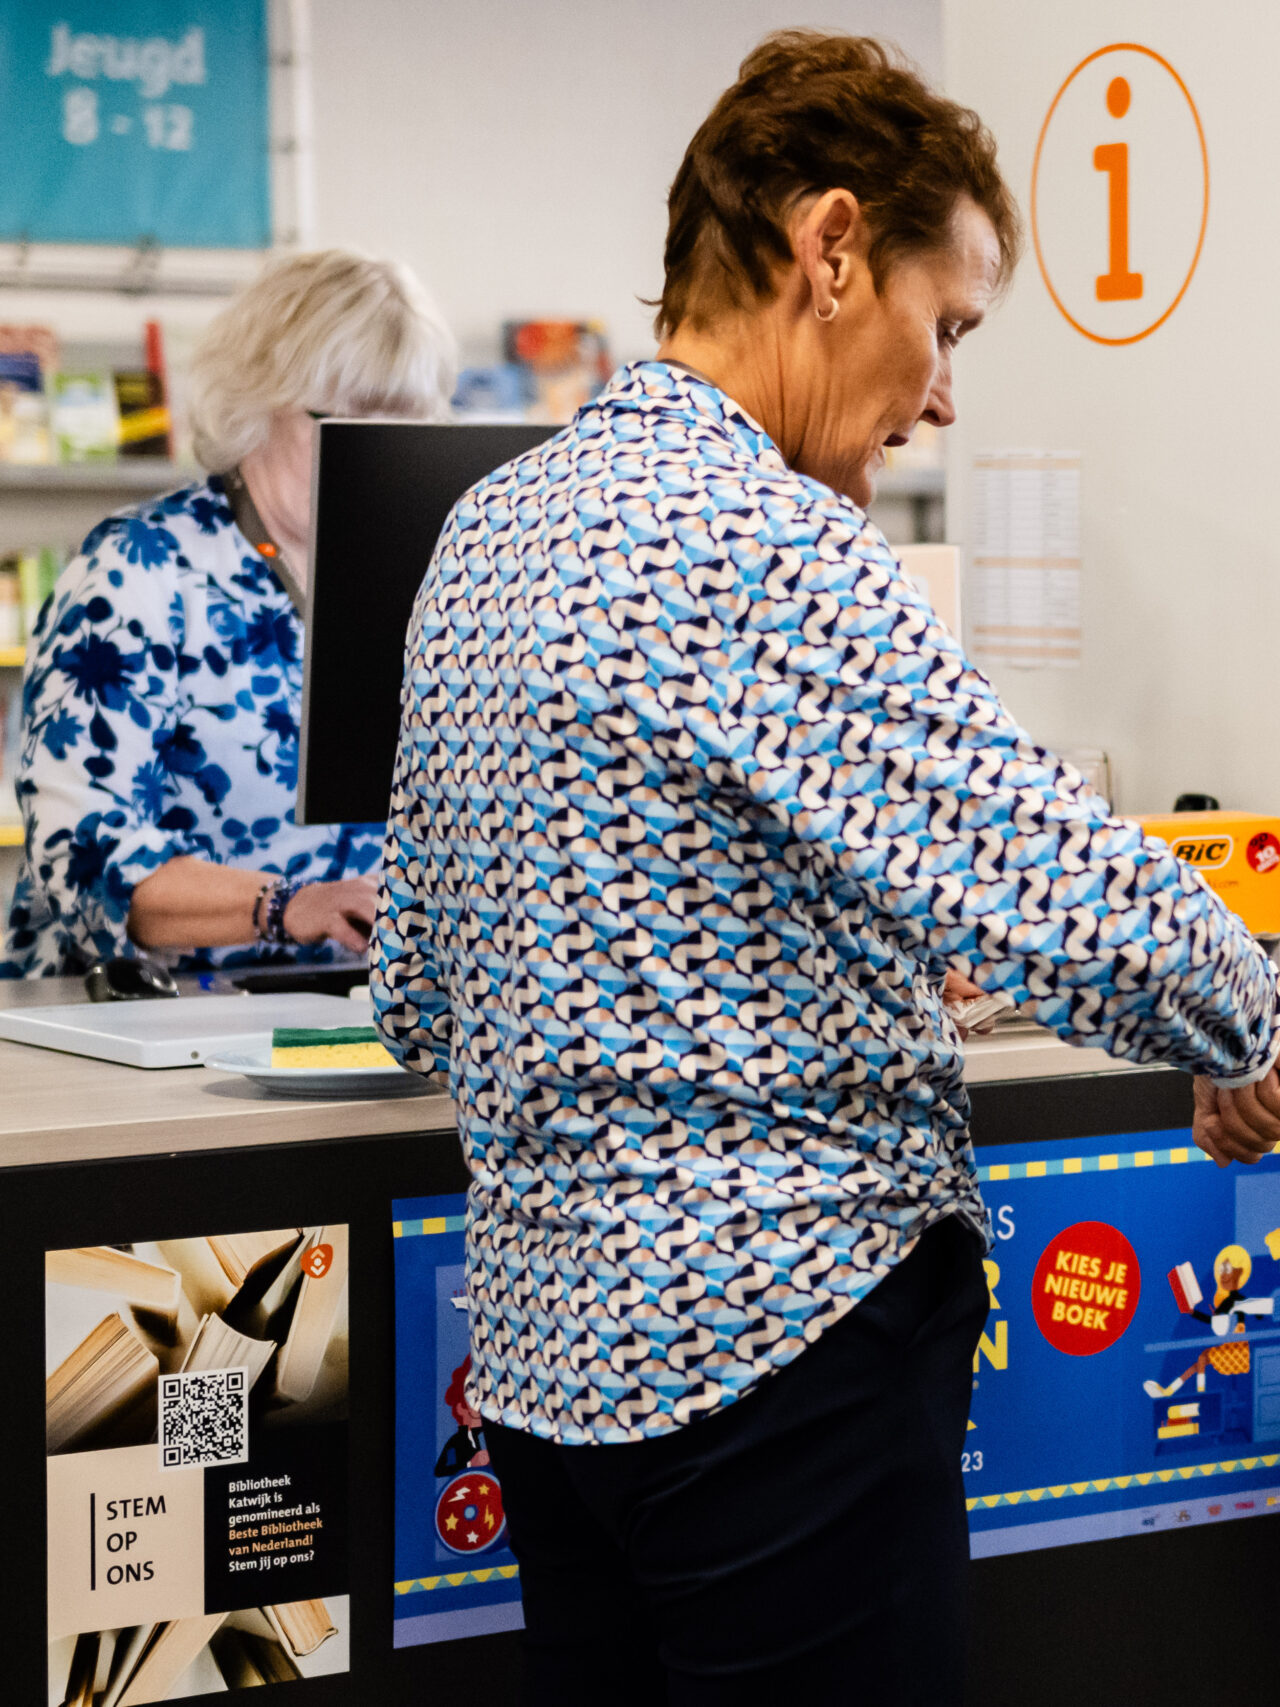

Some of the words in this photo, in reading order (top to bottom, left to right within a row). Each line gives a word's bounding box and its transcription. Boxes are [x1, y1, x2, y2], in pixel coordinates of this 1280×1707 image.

[47, 22, 205, 98] Jeugd
[64, 87, 98, 144] 8
[145, 103, 192, 150] 12
[1055, 1250, 1102, 1279] KIES
[1103, 1262, 1128, 1284] JE
[1043, 1273, 1128, 1310] NIEUWE
[1052, 1300, 1110, 1331] BOEK
[229, 1474, 291, 1493] Bibliotheek
[106, 1495, 166, 1520] STEM
[229, 1493, 271, 1509] Katwijk
[274, 1492, 283, 1503] is
[228, 1504, 303, 1528] genomineerd
[305, 1502, 321, 1515] als
[229, 1527, 259, 1541] Beste
[261, 1517, 323, 1536] Bibliotheek
[106, 1531, 137, 1553] OP
[229, 1546, 250, 1556] van
[252, 1534, 314, 1553] Nederland!
[106, 1561, 155, 1585] ONS
[229, 1560, 257, 1573] Stem
[259, 1556, 271, 1571] jij
[273, 1556, 288, 1568] op
[289, 1550, 315, 1563] ons?
